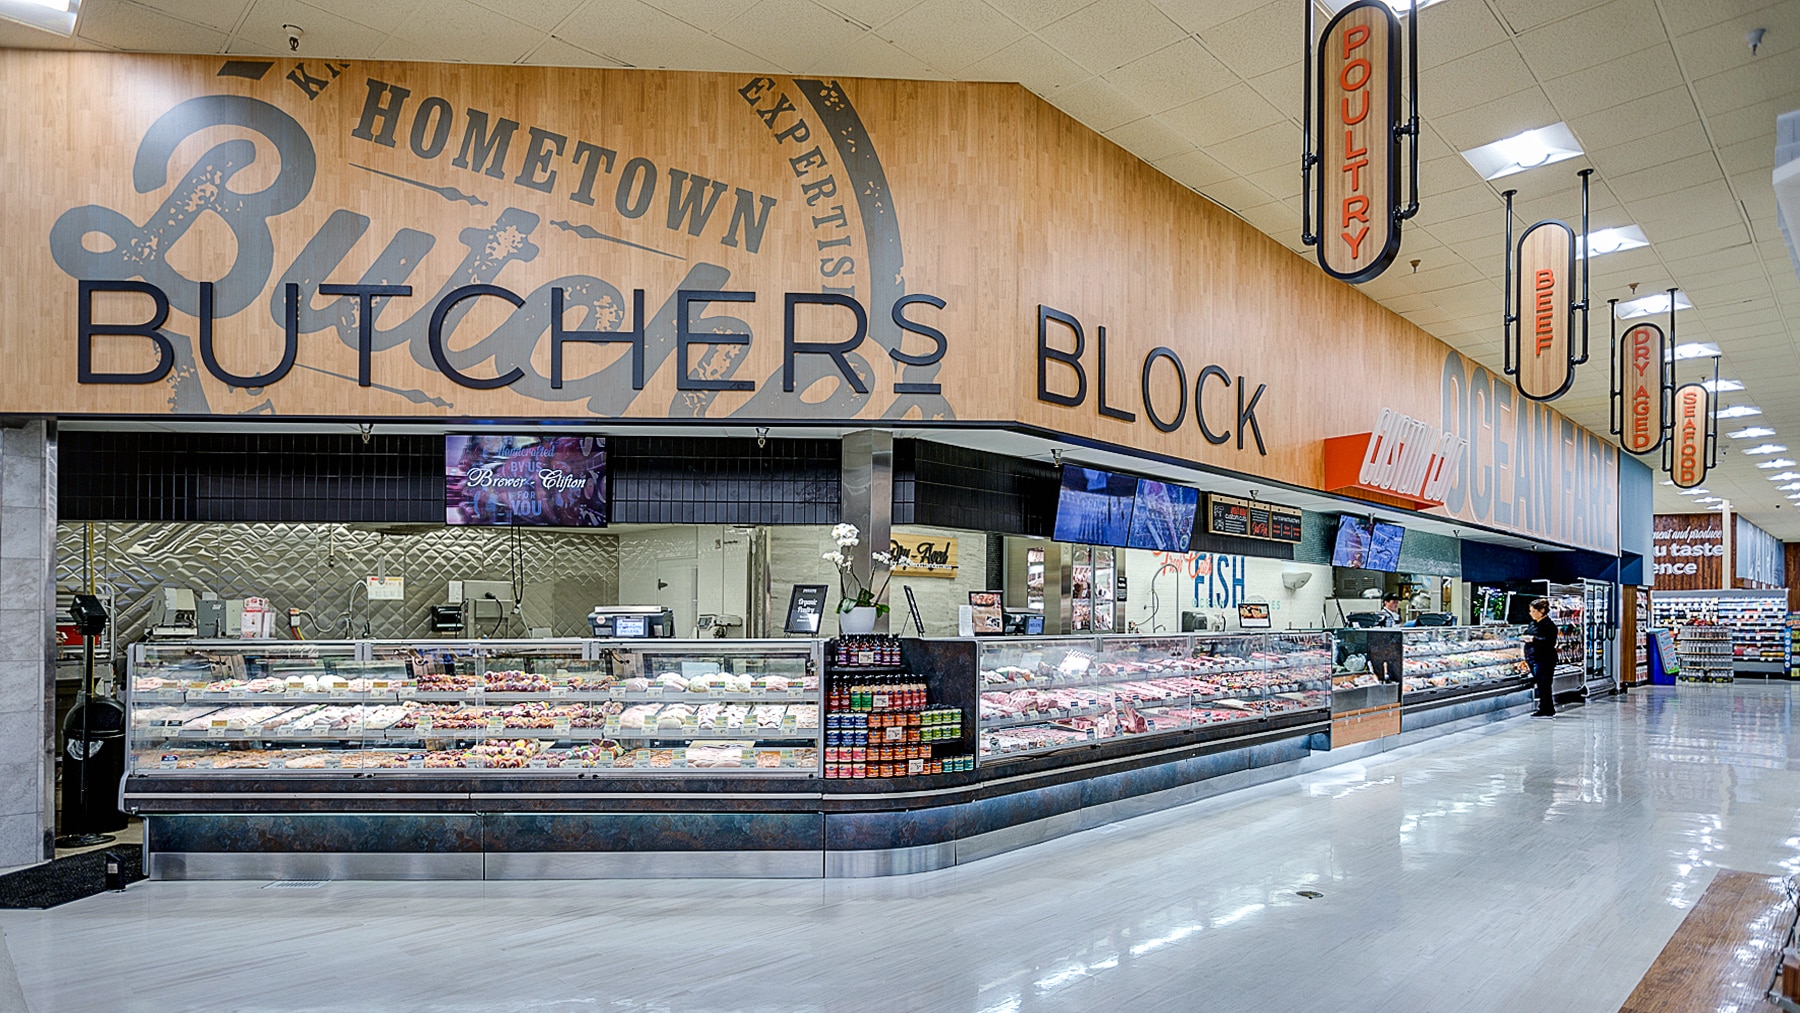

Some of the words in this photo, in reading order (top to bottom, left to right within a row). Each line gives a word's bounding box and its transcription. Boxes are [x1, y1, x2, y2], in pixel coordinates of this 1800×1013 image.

[351, 78, 777, 254] HOMETOWN
[1340, 24, 1372, 260] POULTRY
[1535, 269, 1555, 356] BEEF
[78, 280, 948, 396] BUTCHERS
[1037, 304, 1268, 456] BLOCK
[1633, 329, 1651, 378] DRY
[1632, 385, 1652, 449] AGED
[1683, 392, 1698, 483] SEAFOOD
[511, 461, 525, 472] BY
[527, 461, 542, 473] US
[1441, 350, 1552, 538] OCEAN
[1560, 417, 1615, 552] FARE
[466, 467, 527, 489] Brewer
[538, 468, 587, 493] Clifton
[511, 500, 543, 516] YOU
[517, 491, 536, 499] FOR
[1670, 542, 1724, 557] taste
[1672, 525, 1691, 540] and
[1194, 553, 1246, 609] FISH
